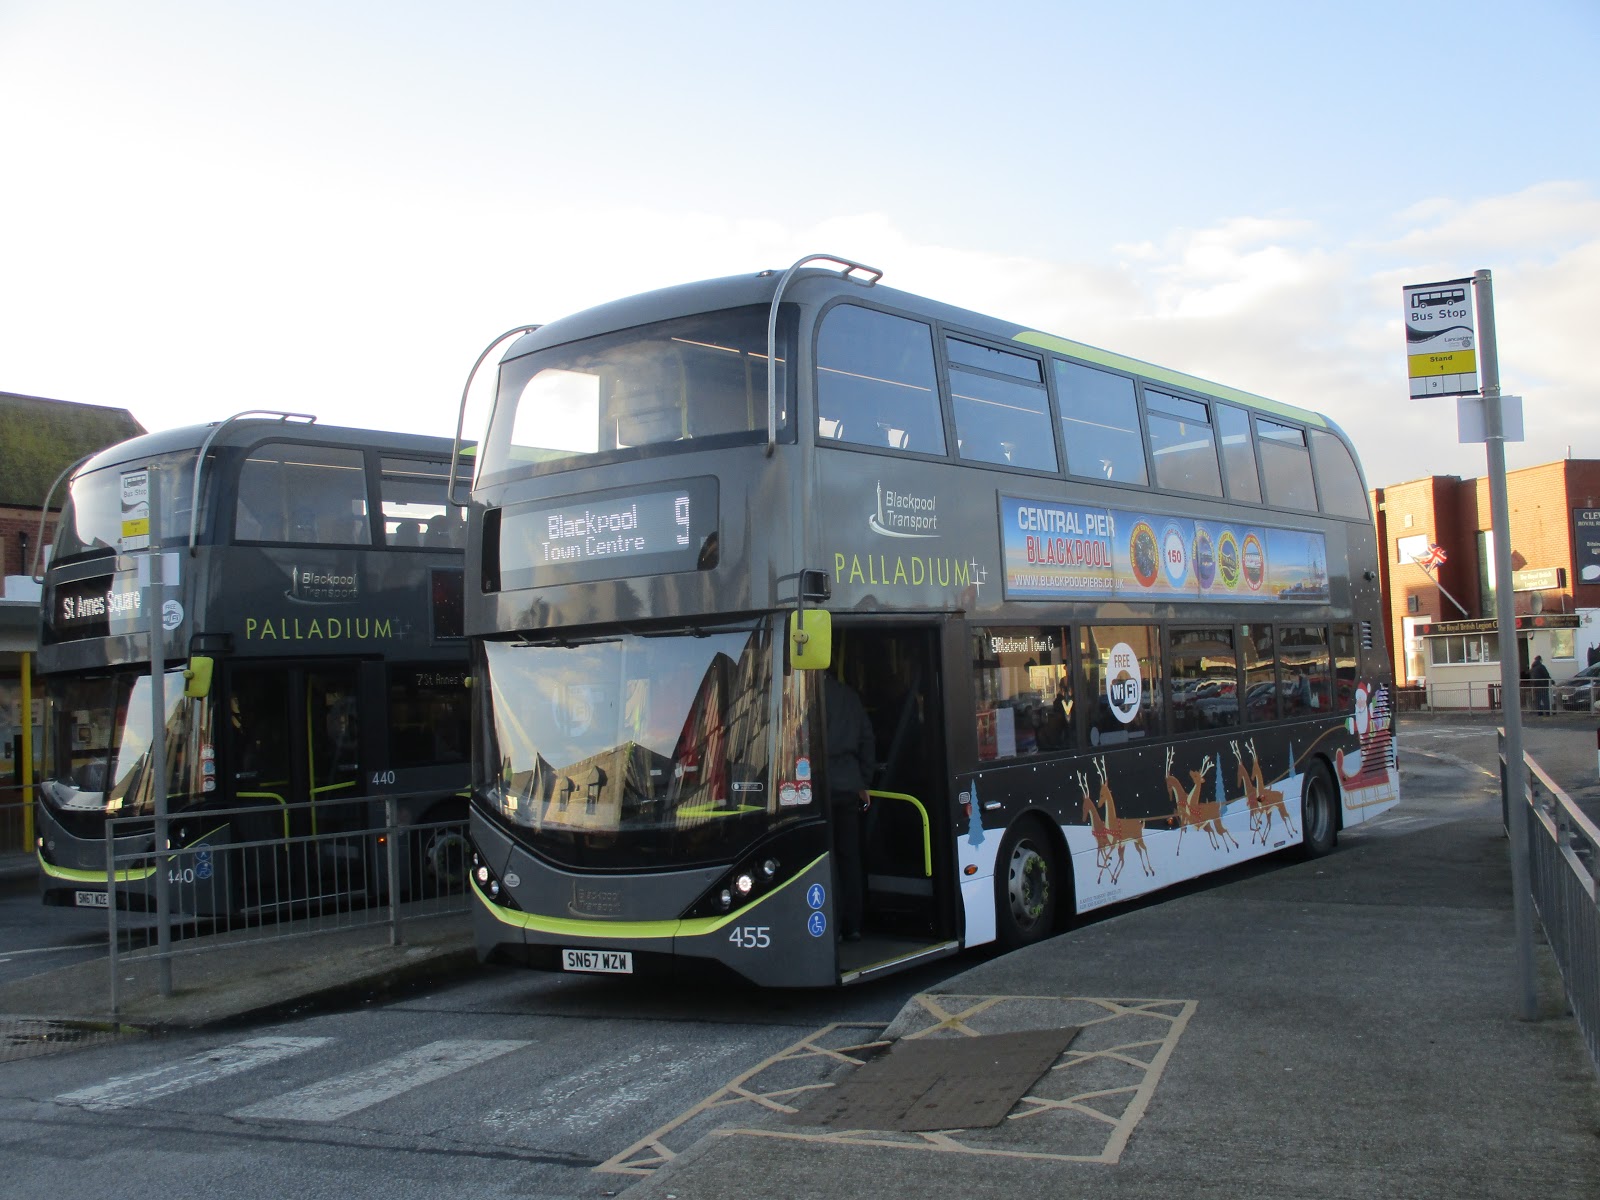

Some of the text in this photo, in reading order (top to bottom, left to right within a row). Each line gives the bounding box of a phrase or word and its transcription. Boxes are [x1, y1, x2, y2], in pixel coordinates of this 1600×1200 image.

[1411, 308, 1467, 321] Bus Stop
[124, 488, 147, 498] Bus Stop
[885, 490, 937, 513] Blackpool
[548, 496, 690, 545] Blackpool 9
[886, 510, 938, 531] Transport
[1017, 506, 1116, 538] CENTRAL PIER
[541, 534, 645, 561] Town Centre
[1026, 534, 1112, 568] BLACKPOOL
[1167, 549, 1182, 564] 150
[834, 552, 971, 587] PALLADIUM
[302, 572, 357, 586] Blackpool
[303, 586, 358, 598] Transport
[63, 590, 141, 620] St Annes Square
[246, 617, 393, 640] PALLADIUM
[1446, 623, 1459, 632] Royal
[1460, 622, 1475, 630] British
[1475, 622, 1492, 631] Legion
[991, 637, 998, 653] 9
[997, 636, 1028, 653] Blackpool
[1029, 636, 1047, 652] Town
[1114, 654, 1131, 668] FREE
[372, 770, 396, 786] 440
[578, 888, 621, 902] Blackpool
[729, 926, 771, 948] 455
[568, 952, 627, 970] SN67 WZW
